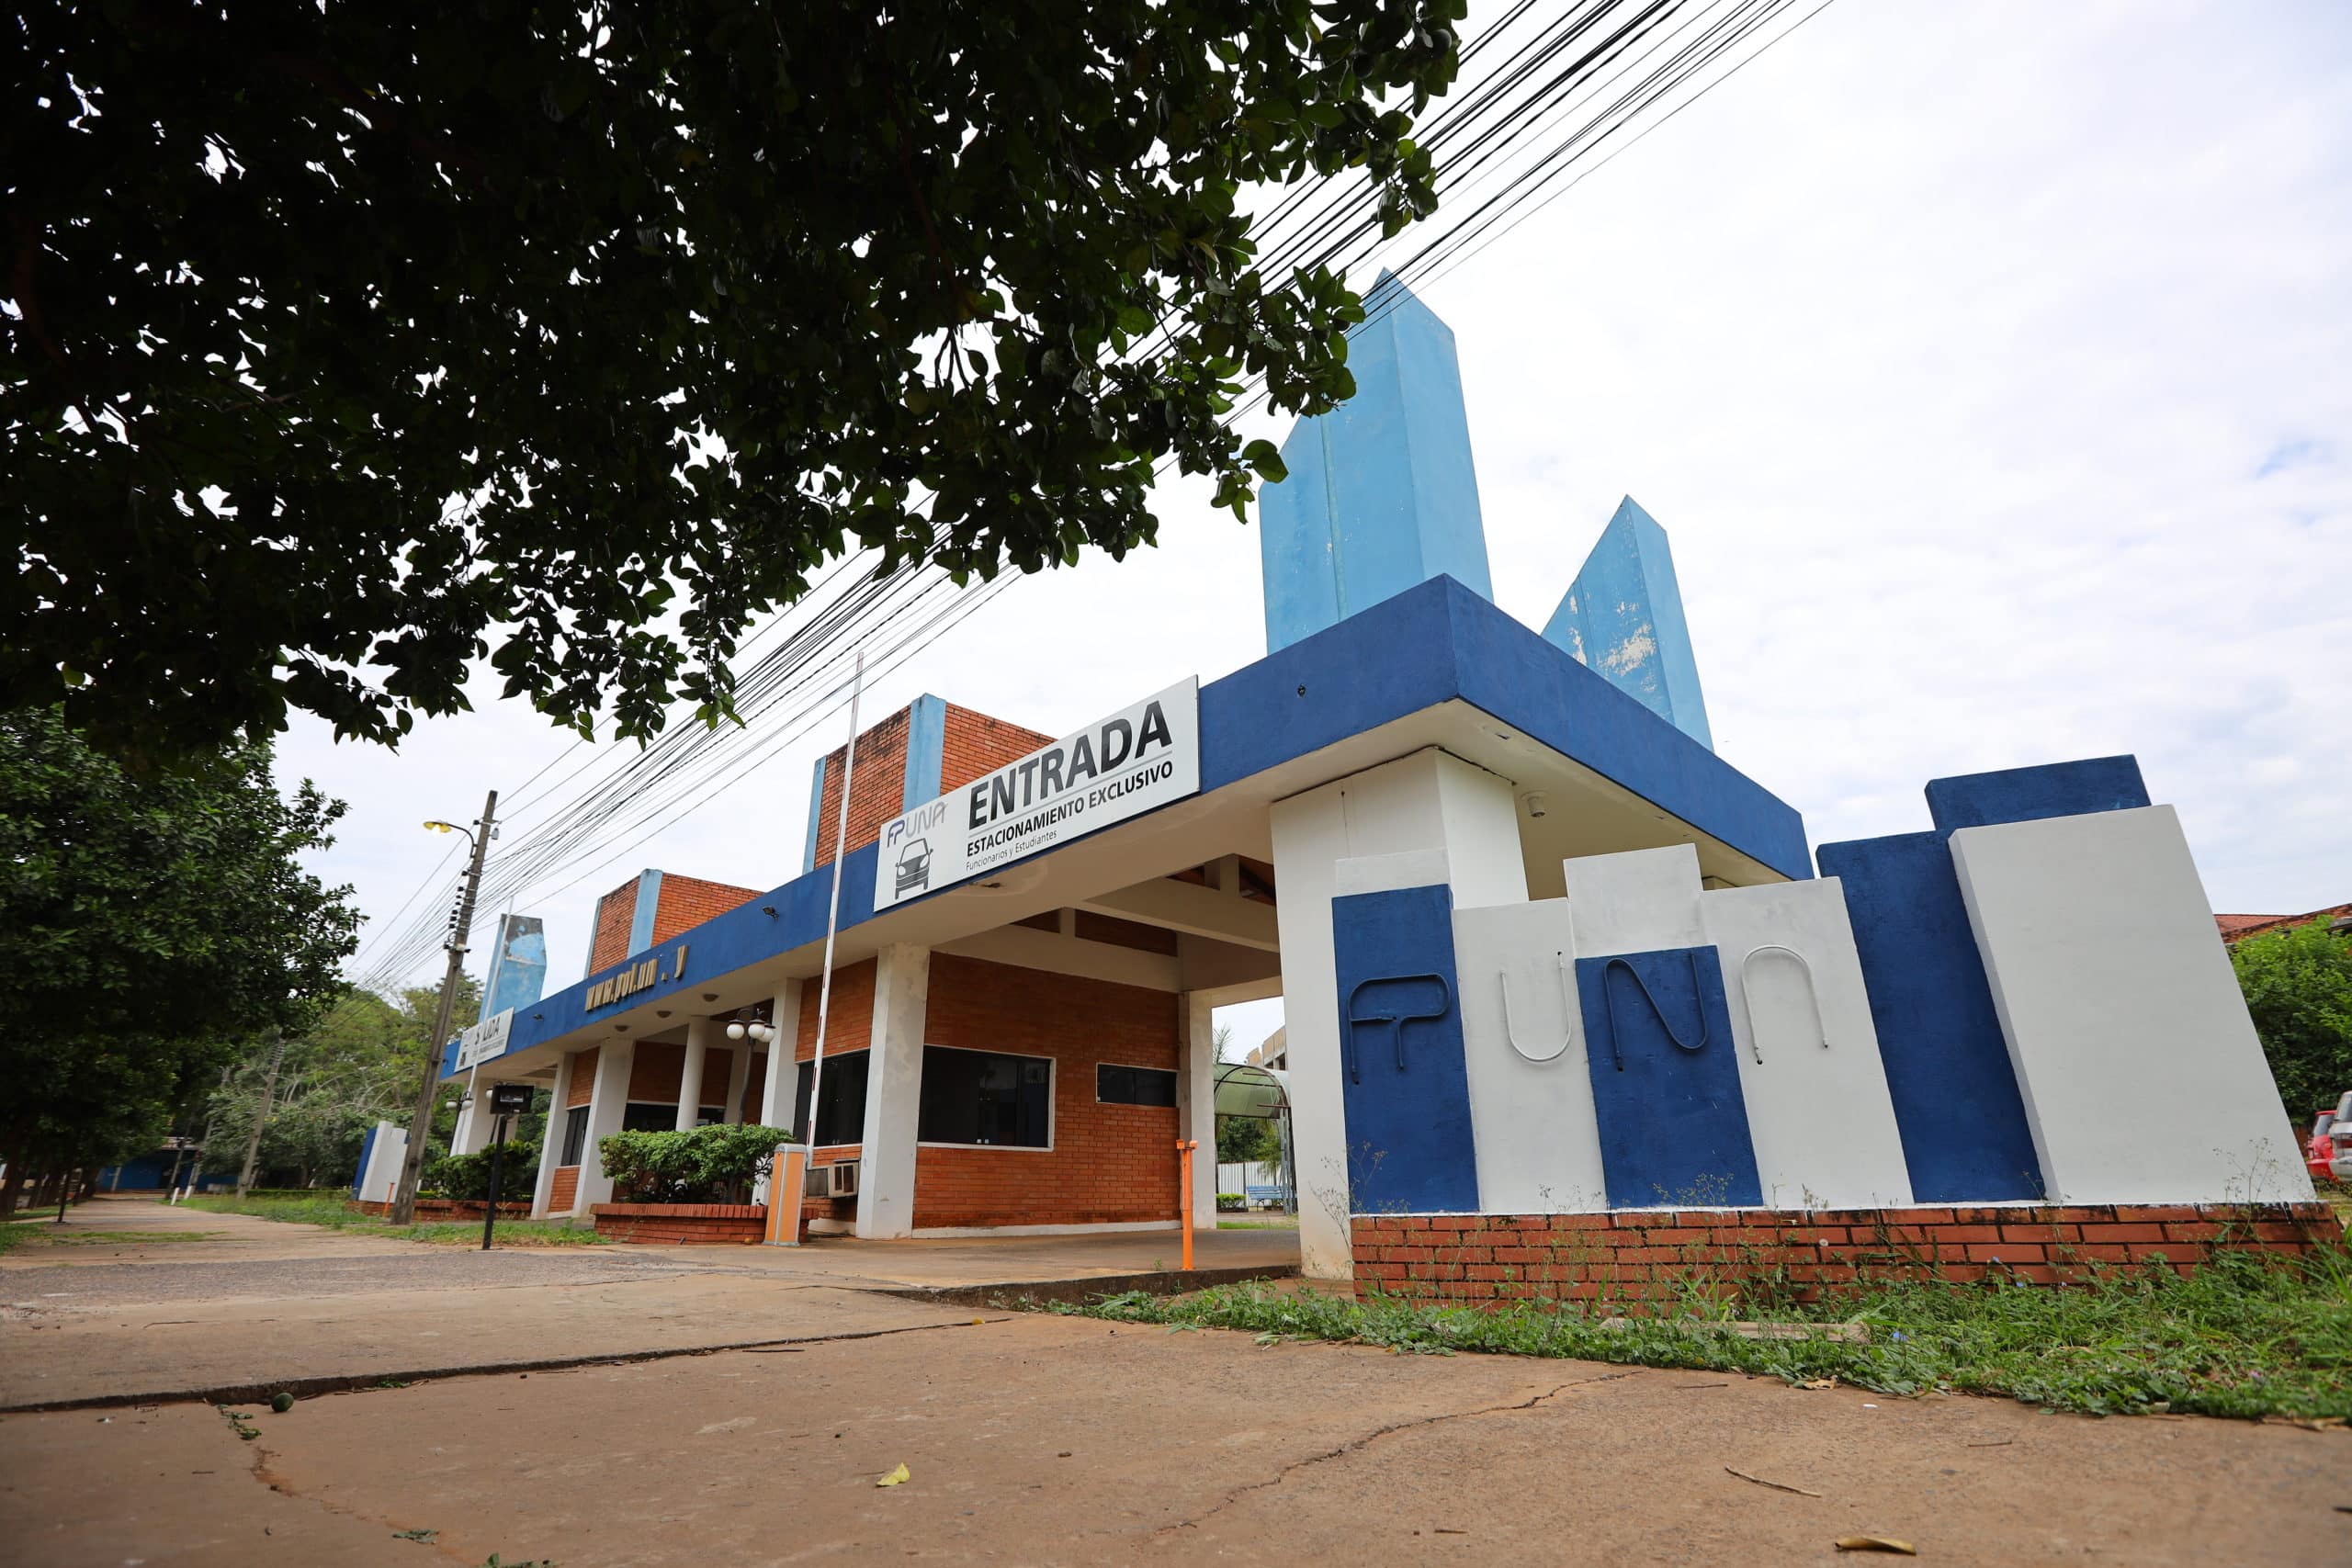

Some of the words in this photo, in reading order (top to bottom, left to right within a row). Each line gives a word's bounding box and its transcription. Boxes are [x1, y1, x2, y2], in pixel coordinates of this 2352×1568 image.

[969, 700, 1172, 830] ENTRADA
[967, 796, 1085, 857] ESTACIONAMIENTO
[1089, 761, 1173, 808] EXCLUSIVO
[966, 849, 1008, 872] Funcionarios
[1015, 830, 1057, 853] Estudiantes
[474, 1016, 500, 1045] SLIDA
